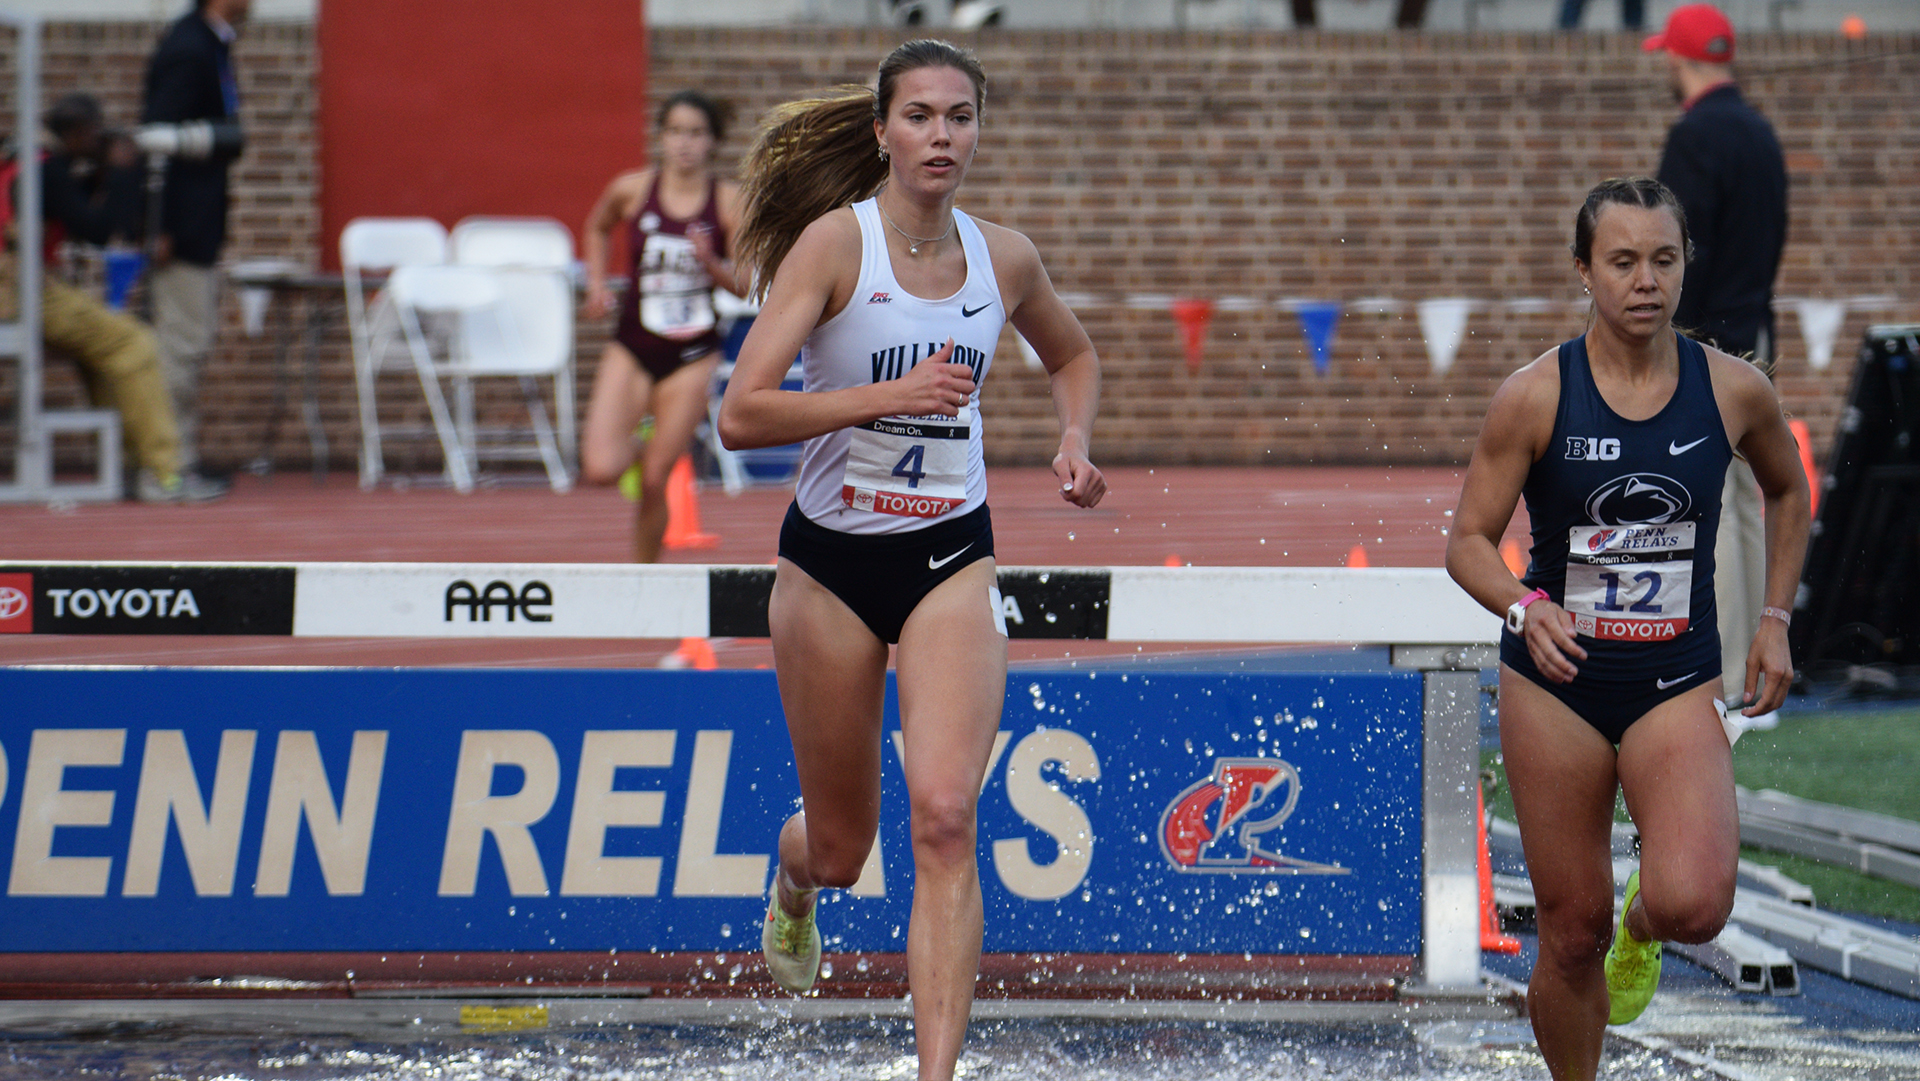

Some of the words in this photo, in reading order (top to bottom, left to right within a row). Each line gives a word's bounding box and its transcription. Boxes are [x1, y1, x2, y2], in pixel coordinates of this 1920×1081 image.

[873, 421, 905, 434] Dream
[907, 426, 923, 436] On.
[891, 445, 926, 489] 4
[880, 494, 951, 515] TOYOTA
[1626, 527, 1667, 539] PENN
[1621, 536, 1679, 549] RELAYS
[1588, 555, 1619, 564] Dream
[1621, 554, 1638, 563] On.
[1594, 570, 1663, 613] 12
[47, 588, 200, 618] TOYOTA
[1600, 622, 1676, 637] TOYOTA
[0, 728, 390, 897] ENN
[437, 728, 1102, 901] RELS
